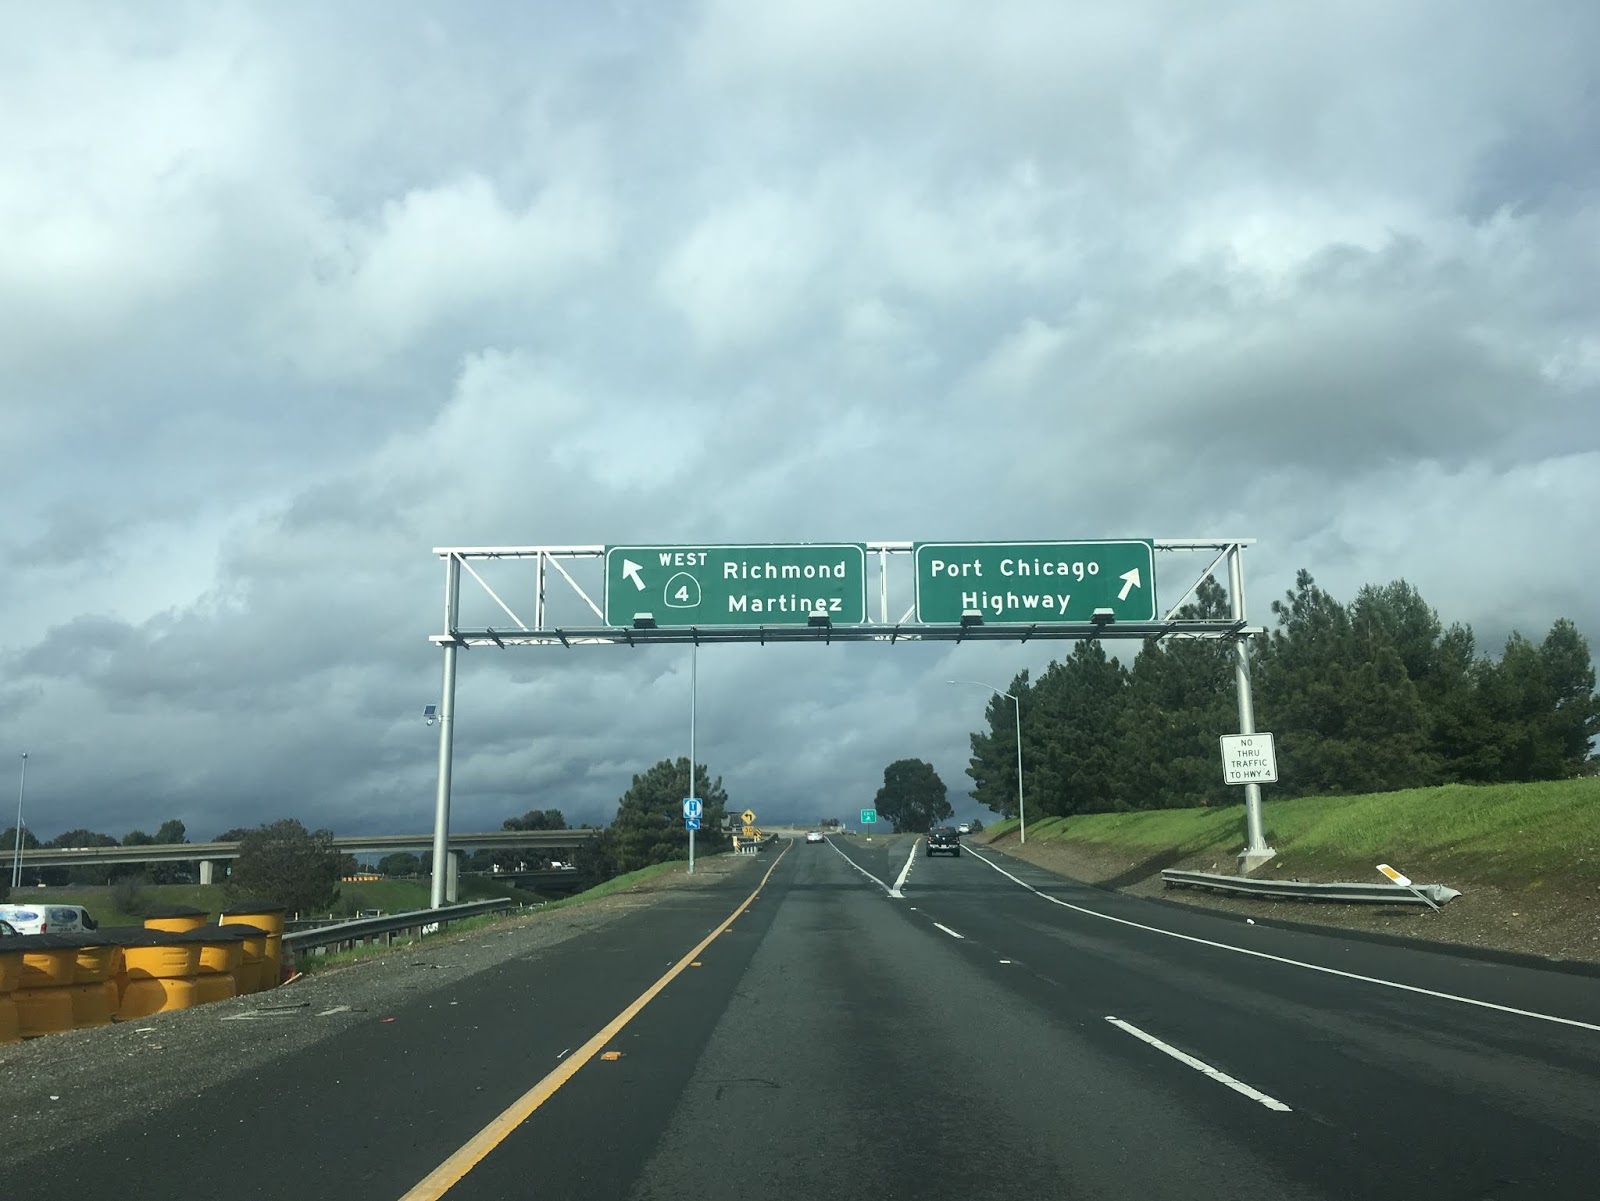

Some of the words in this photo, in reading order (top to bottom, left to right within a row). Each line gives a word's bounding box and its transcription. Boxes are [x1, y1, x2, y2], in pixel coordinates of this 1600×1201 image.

[659, 552, 708, 567] WEST
[723, 561, 846, 580] Richmond
[931, 559, 983, 577] Port
[1000, 558, 1100, 582] Chicago
[674, 585, 689, 602] 4
[728, 594, 843, 613] Martinez
[962, 591, 1071, 616] Highway
[1240, 738, 1253, 747] NO
[1237, 749, 1260, 757] THRU
[1231, 759, 1268, 768] TRAFFIC
[1230, 771, 1242, 779] TO
[1243, 770, 1262, 778] HWY
[1265, 769, 1271, 777] 4
